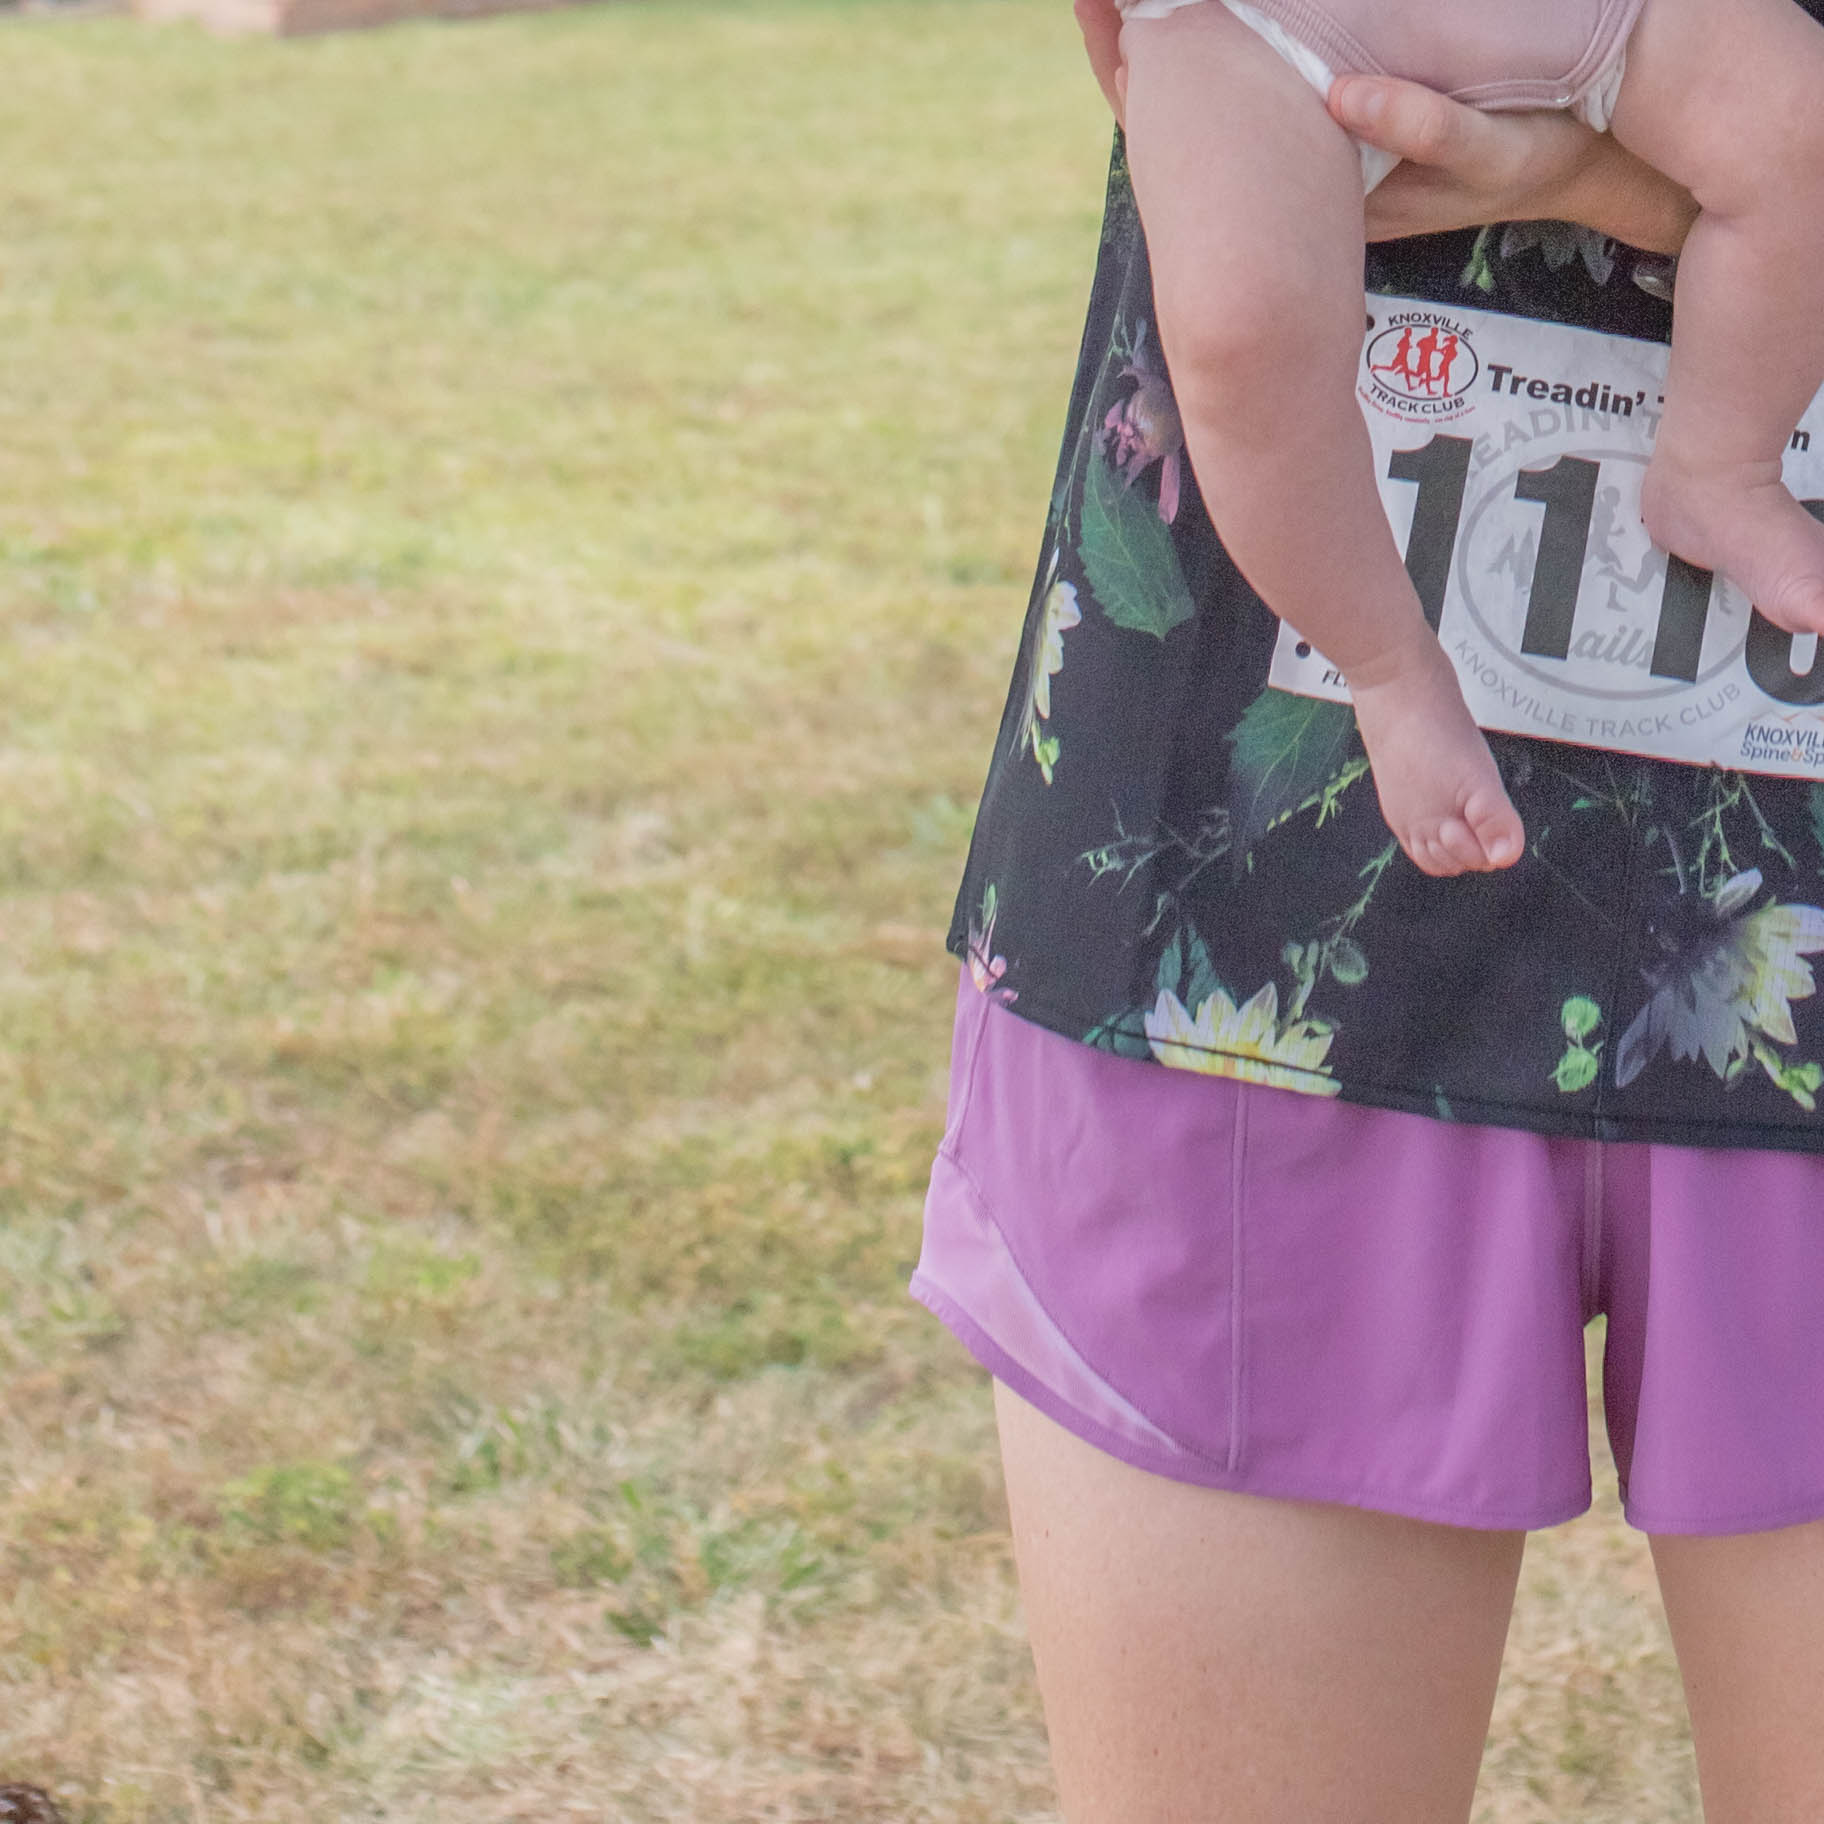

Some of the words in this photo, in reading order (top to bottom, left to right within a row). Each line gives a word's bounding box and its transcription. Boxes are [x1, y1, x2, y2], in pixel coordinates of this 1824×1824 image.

[1388, 312, 1474, 341] KNOXVILLE
[1369, 383, 1420, 413] TRACK
[1421, 396, 1465, 414] CLUB
[1487, 363, 1646, 417] Treadin'
[1455, 639, 1577, 734] KNOXVILLE
[1585, 716, 1673, 738] TRACK
[1679, 682, 1741, 727] CLUB
